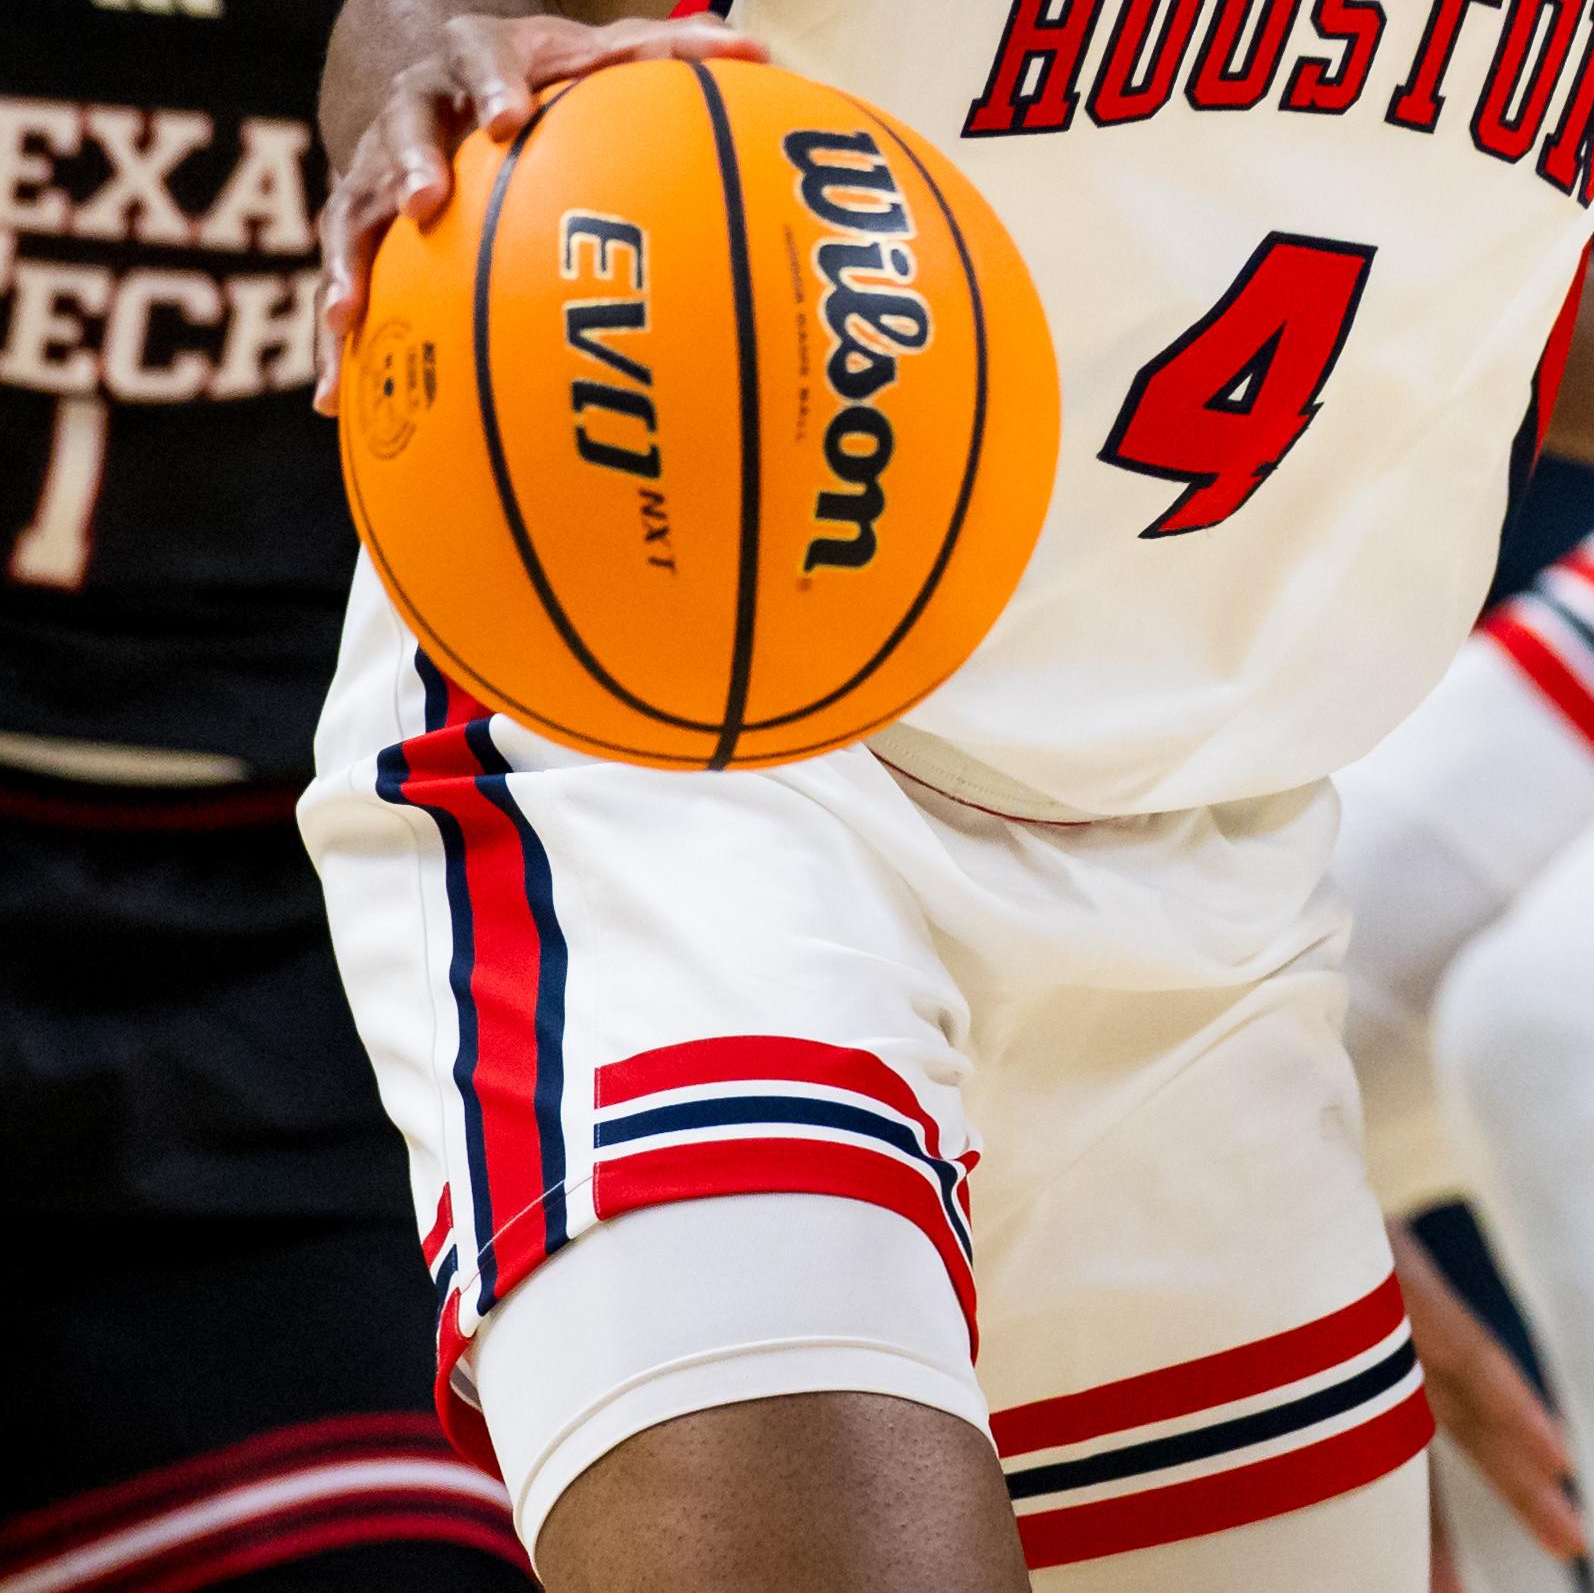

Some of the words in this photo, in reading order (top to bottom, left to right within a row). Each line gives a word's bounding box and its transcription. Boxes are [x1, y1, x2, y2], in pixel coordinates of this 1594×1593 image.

[0, 94, 320, 254] EXA
[0, 251, 320, 404] ECH
[559, 208, 663, 480] EVO
[638, 487, 677, 576] NXT
[780, 128, 932, 574] Wilson
[1096, 230, 1378, 540] 4
[8, 394, 109, 594] 1
